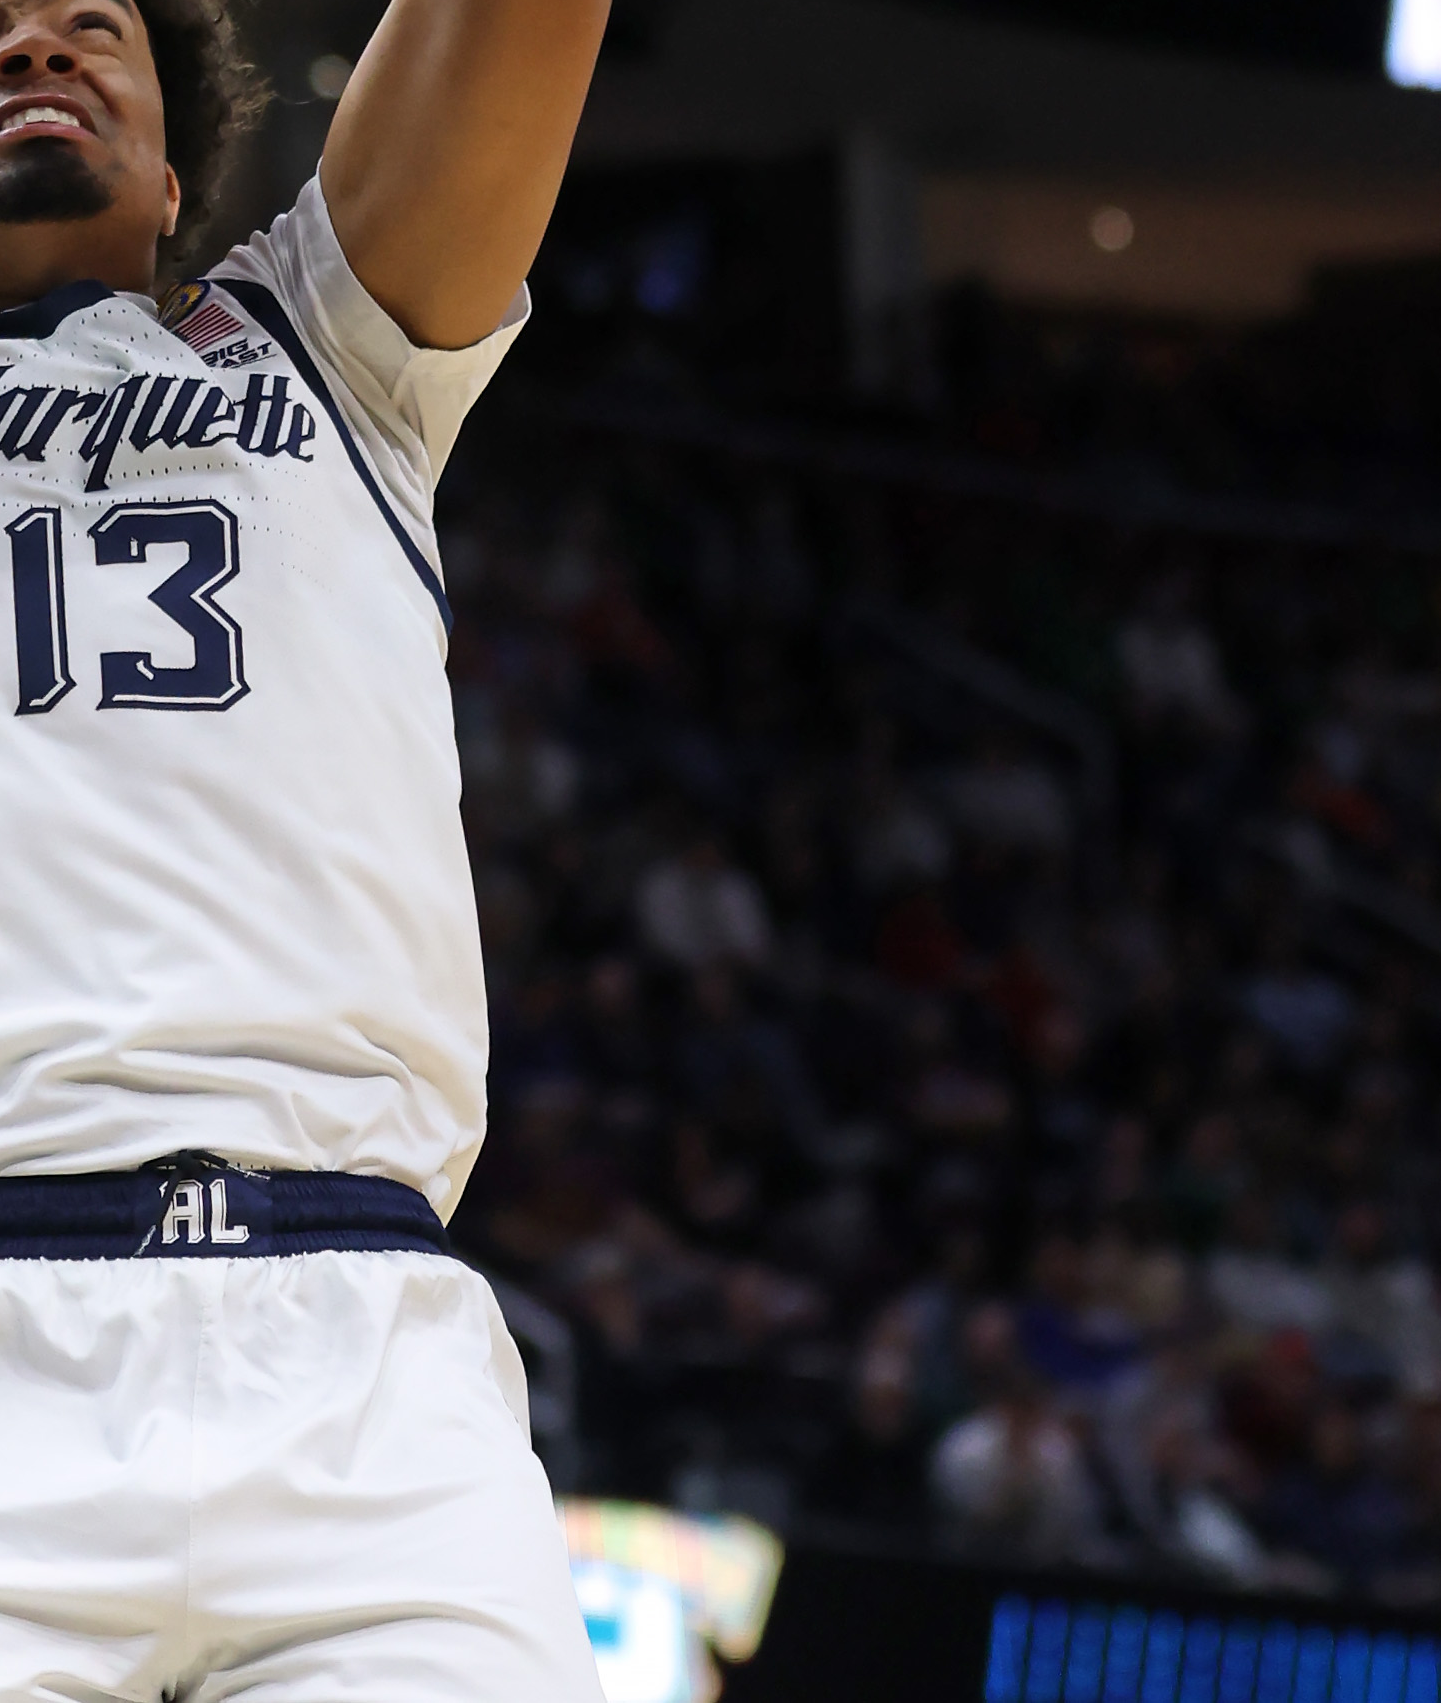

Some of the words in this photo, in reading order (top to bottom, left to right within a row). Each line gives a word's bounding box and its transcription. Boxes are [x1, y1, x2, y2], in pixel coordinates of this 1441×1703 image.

[208, 341, 273, 369] AST
[4, 498, 252, 717] 13
[160, 1179, 250, 1245] AL
